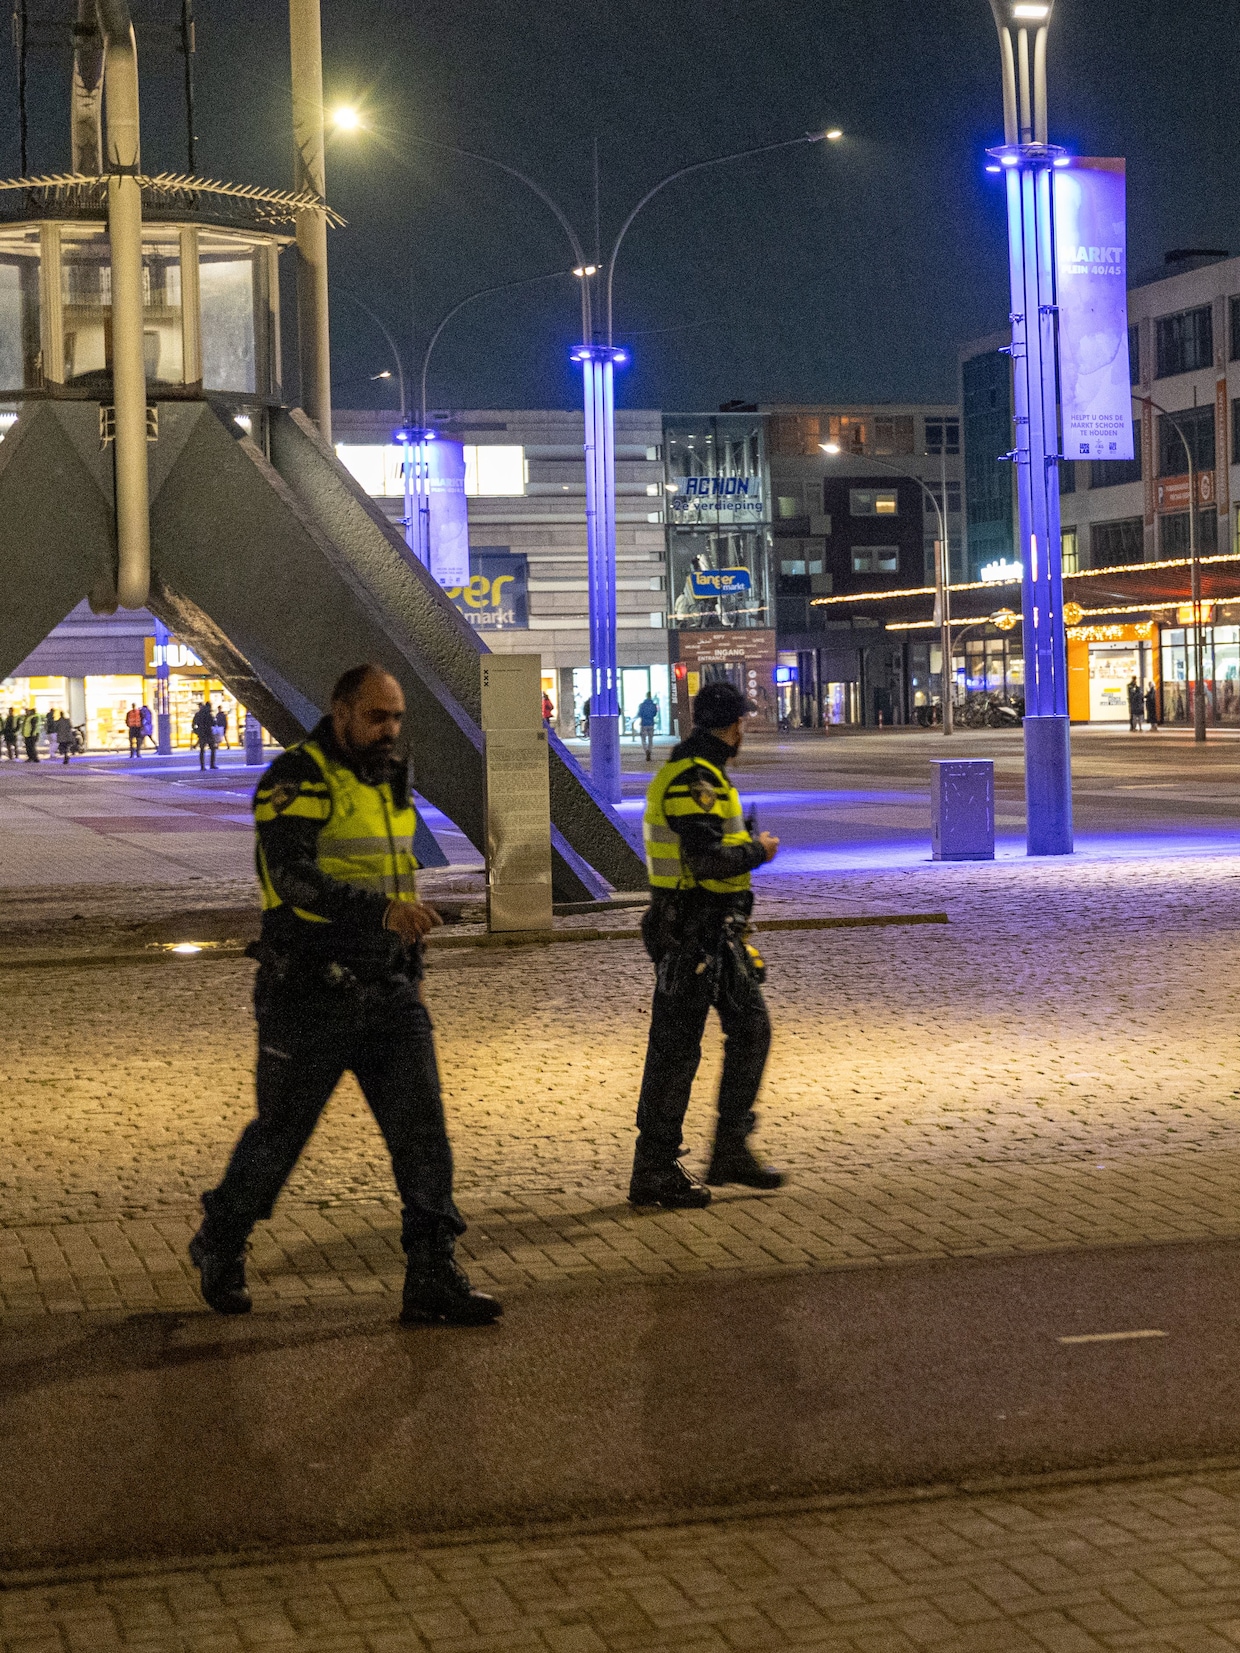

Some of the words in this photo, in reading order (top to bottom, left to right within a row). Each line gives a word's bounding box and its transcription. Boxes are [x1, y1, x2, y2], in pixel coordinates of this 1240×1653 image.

[1091, 265, 1122, 275] 40/45
[685, 477, 749, 495] ACTION
[673, 500, 690, 511] 2e
[694, 499, 762, 512] verdieping
[693, 571, 736, 589] Tanger
[722, 583, 745, 591] markt
[714, 648, 745, 656] INGANG
